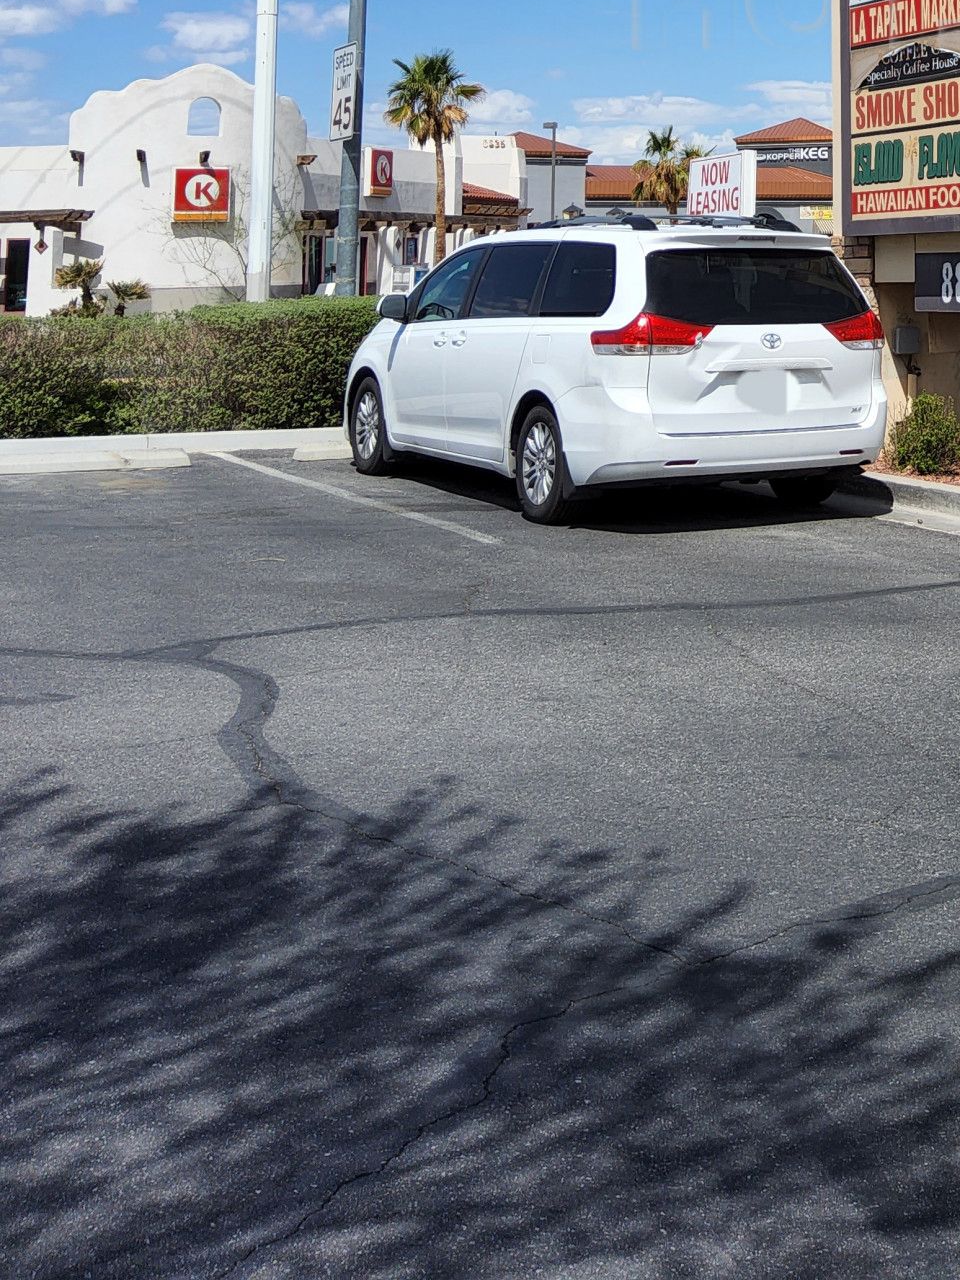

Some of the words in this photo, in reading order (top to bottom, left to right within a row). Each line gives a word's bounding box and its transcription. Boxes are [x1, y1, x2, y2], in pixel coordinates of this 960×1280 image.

[852, 10, 867, 44] LA
[335, 52, 354, 70] SPEED
[903, 60, 931, 75] Coffee
[932, 56, 959, 70] House
[336, 73, 351, 90] LIMIT
[333, 96, 351, 131] 45
[856, 88, 916, 129] SMOKE
[801, 147, 828, 159] KEG
[854, 139, 904, 186] ISLAND
[701, 161, 730, 186] NOW
[195, 181, 216, 203] K
[689, 187, 739, 215] LEASING
[857, 189, 928, 213] HAWAIIAN
